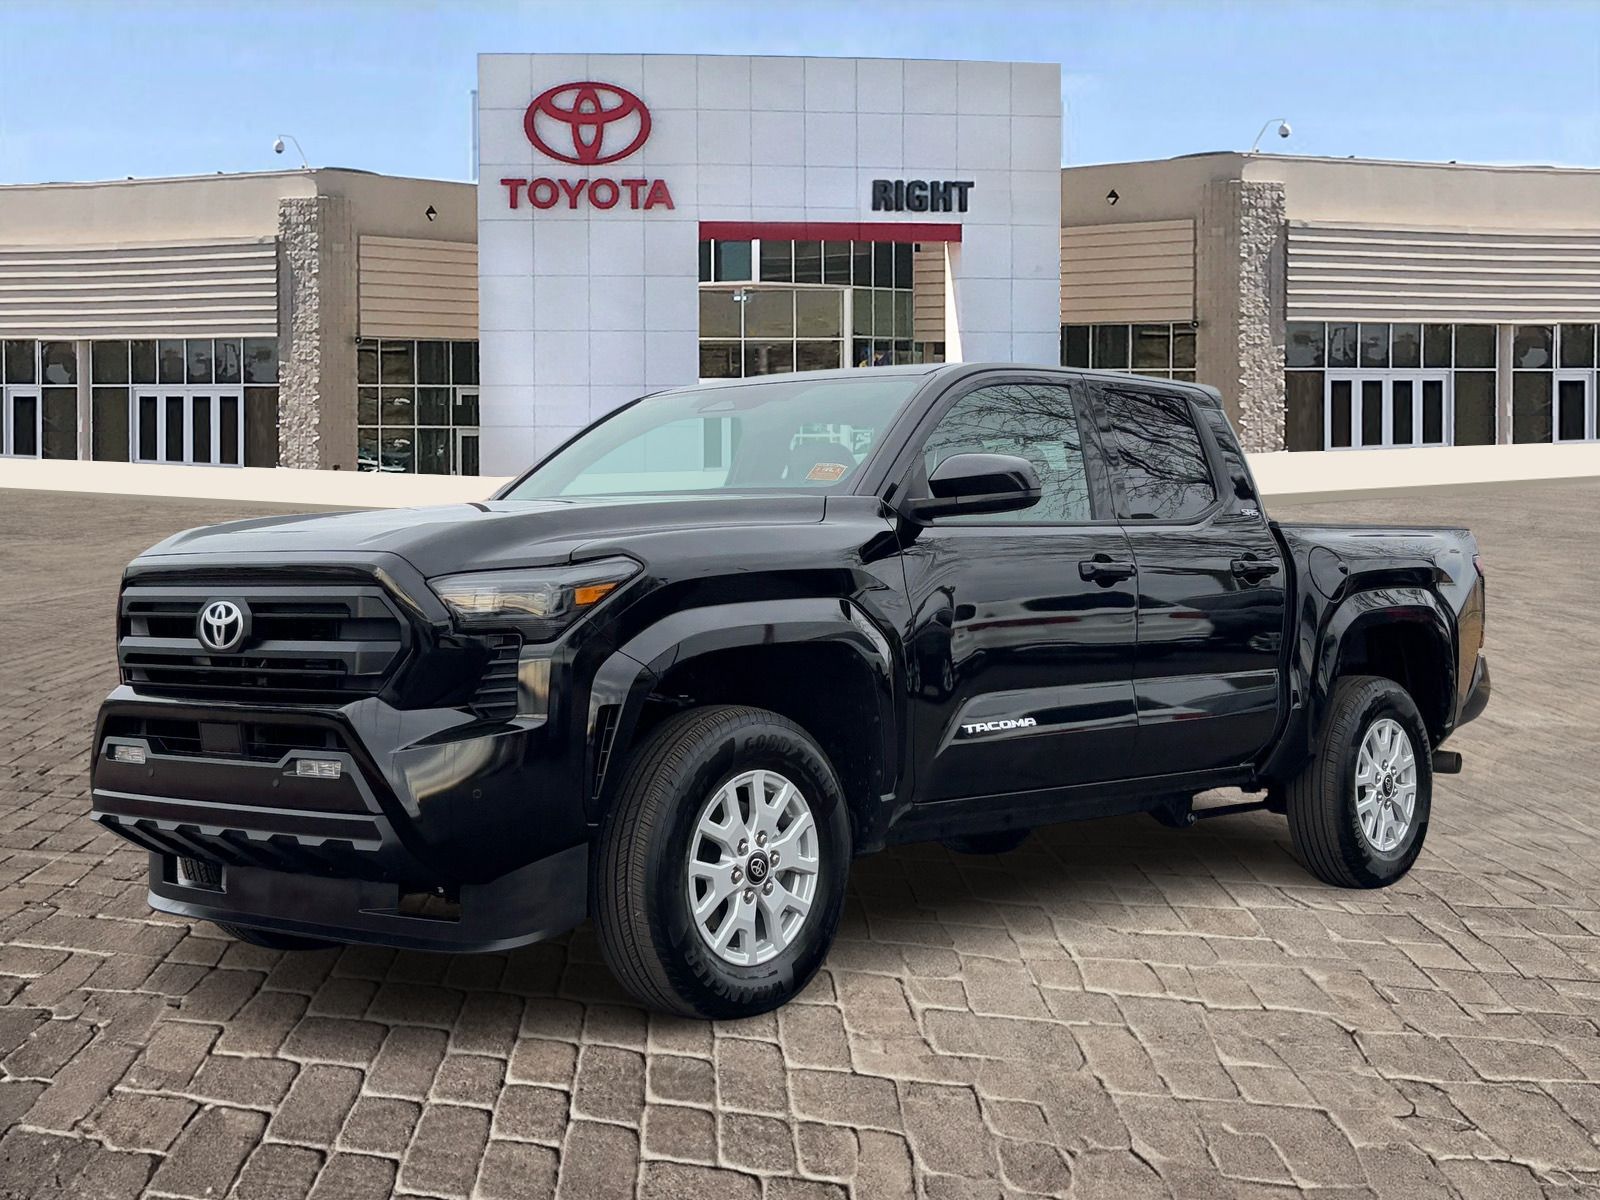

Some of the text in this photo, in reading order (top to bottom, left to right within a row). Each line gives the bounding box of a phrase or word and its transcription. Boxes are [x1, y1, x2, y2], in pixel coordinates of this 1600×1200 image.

[501, 178, 675, 210] TOYOTA
[872, 180, 974, 212] RIGHT
[961, 717, 1037, 734] TACOMA
